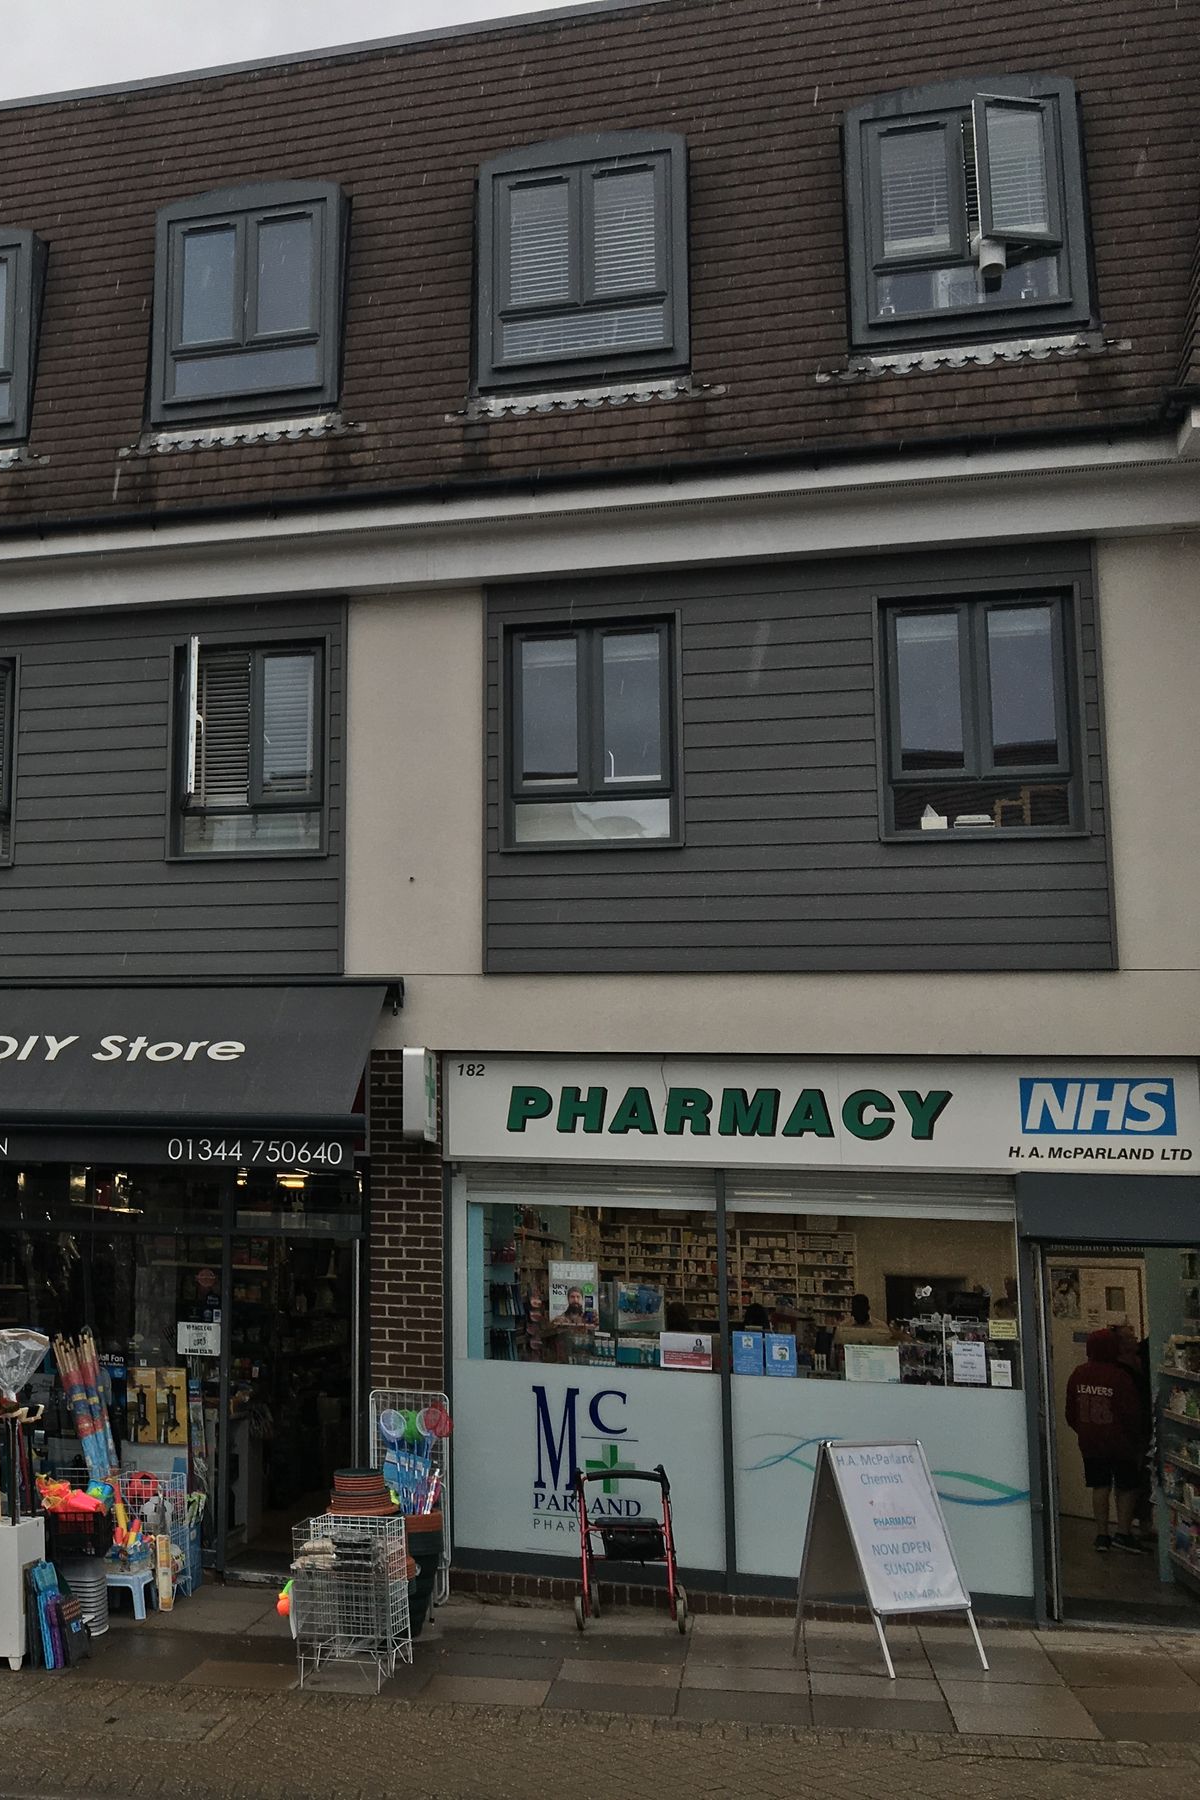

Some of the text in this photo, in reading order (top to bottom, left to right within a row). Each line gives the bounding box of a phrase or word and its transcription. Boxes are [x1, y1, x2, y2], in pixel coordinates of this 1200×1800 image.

[91, 1034, 246, 1062] Store
[456, 1064, 485, 1077] 182
[506, 1085, 953, 1141] PHARMACY
[1025, 1082, 1169, 1132] NHS
[167, 1138, 343, 1165] 01344 750640
[1008, 1146, 1193, 1161] H. A. McPARLAND LTD
[1076, 1384, 1114, 1397] LEAVERS
[860, 1473, 904, 1485] Chemist
[533, 1492, 641, 1517] PARAND
[873, 1516, 917, 1527] PHARMACY
[872, 1541, 932, 1557] NOW OPEN
[884, 1561, 934, 1576] SUNDAYS
